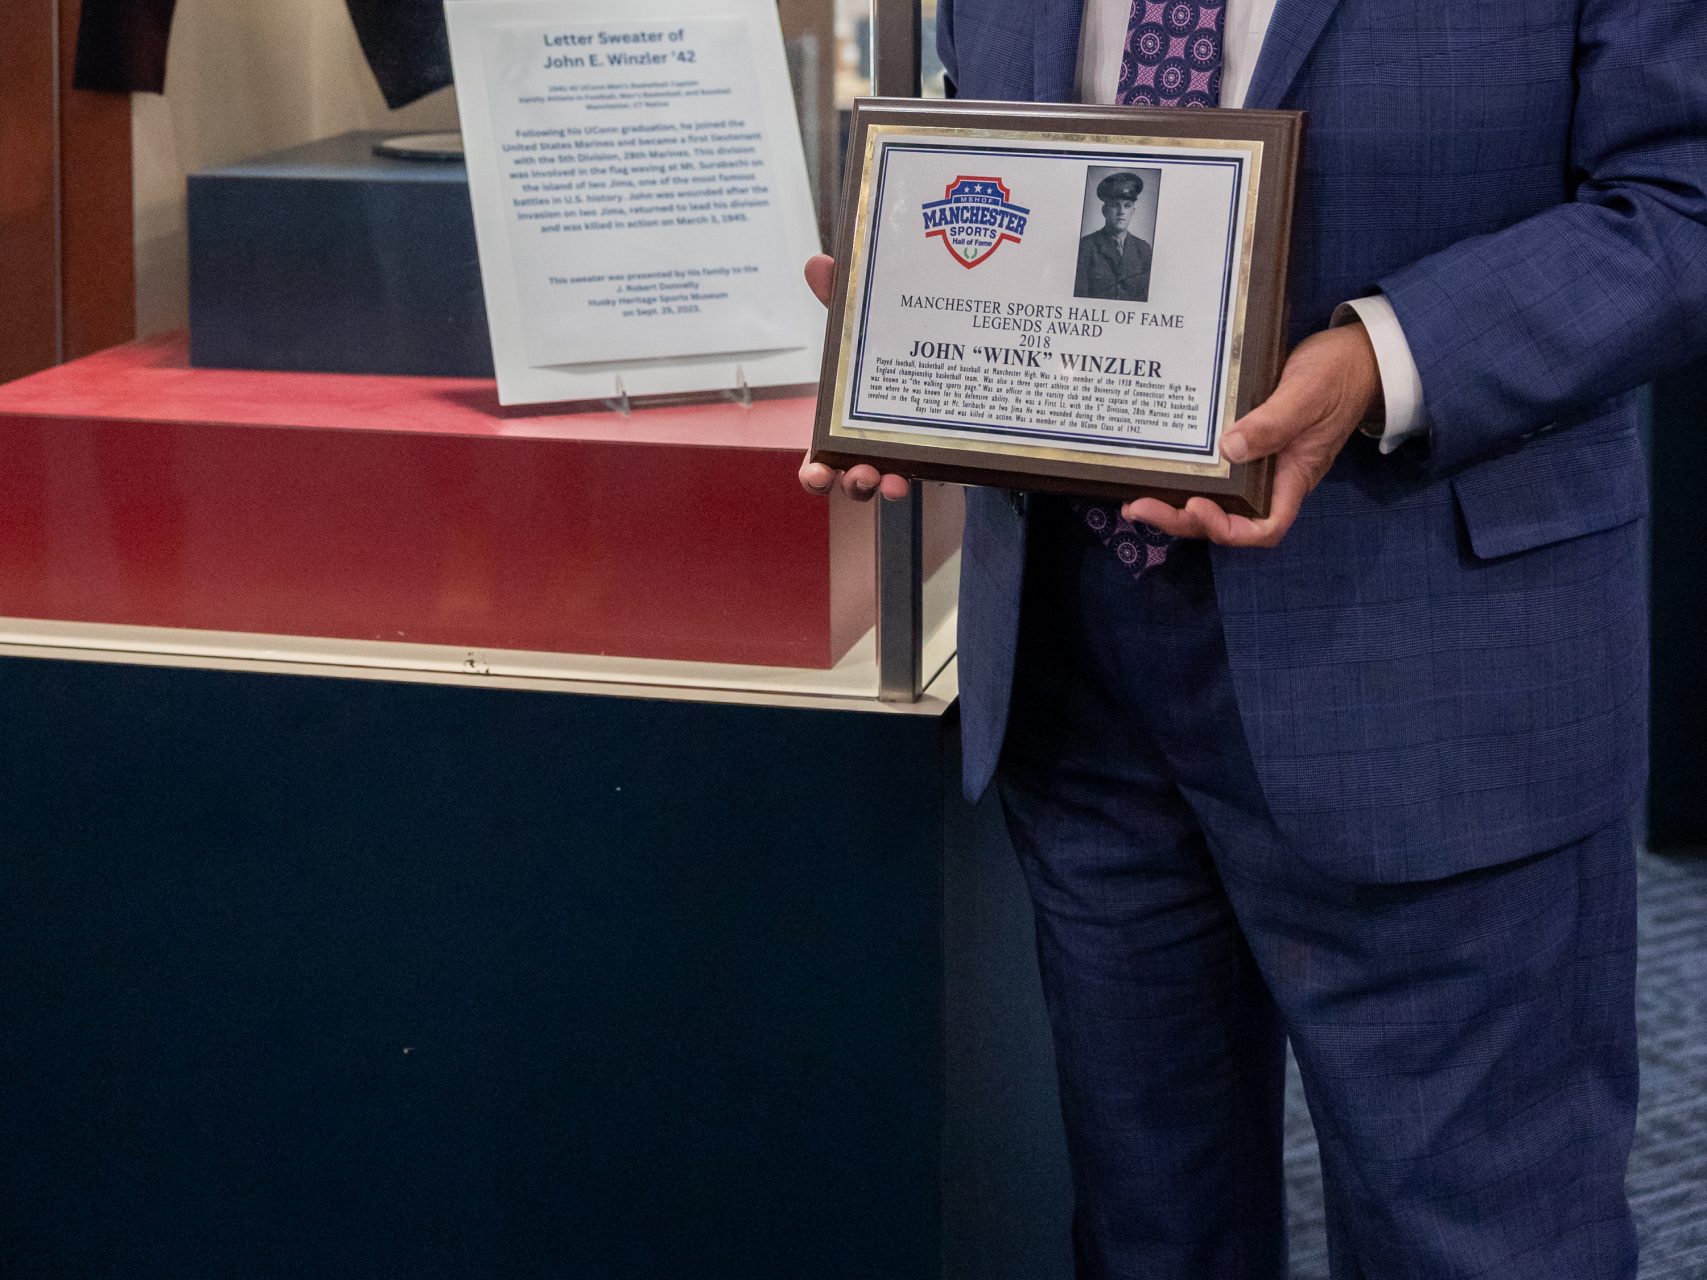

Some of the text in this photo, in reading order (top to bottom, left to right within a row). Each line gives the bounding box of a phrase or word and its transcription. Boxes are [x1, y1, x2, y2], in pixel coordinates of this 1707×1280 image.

[543, 28, 684, 46] Letter Sweater of
[543, 49, 695, 69] John E. Winzler '42
[960, 196, 993, 204] MSHOF
[922, 205, 1027, 236] MANCHESTER
[950, 226, 997, 239] SPORTS
[900, 294, 1184, 329] MANCHESTER SPORTS HALL OF FAME
[972, 315, 1103, 338] LEGENDS AWARD
[1019, 334, 1051, 349] 2018
[909, 340, 966, 361] JOHN
[1060, 353, 1162, 379] WINZLER
[875, 365, 896, 375] England
[898, 367, 932, 379] championship
[935, 371, 961, 380] basketball
[983, 375, 993, 383] Was
[996, 376, 1007, 384] also
[1016, 378, 1030, 386] three
[1033, 381, 1047, 389] sport
[1050, 382, 1069, 390] athlete
[1093, 385, 1120, 397] University
[1132, 388, 1164, 399] Connecticut
[1167, 392, 1184, 400] where
[876, 356, 892, 366] Played
[895, 358, 916, 368] football,
[918, 360, 944, 369] basketball
[959, 364, 981, 373] baseball
[992, 367, 1021, 376] Manchester
[1039, 371, 1050, 379] Was
[1072, 375, 1093, 383] member
[1096, 376, 1102, 384] of
[1105, 377, 1114, 385] the
[1134, 379, 1165, 389] Manchester
[1168, 383, 1181, 393] High
[1184, 384, 1196, 392] New
[882, 374, 898, 383] known
[923, 379, 943, 389] walking
[944, 382, 961, 391] sports
[982, 384, 992, 392] Was
[1005, 386, 1022, 395] officer
[1034, 389, 1043, 397] the
[1045, 392, 1064, 401] varsity
[1067, 392, 1078, 400] club
[1108, 397, 1128, 405] captain
[1140, 399, 1149, 407] the
[1153, 400, 1166, 408] 1942
[1170, 401, 1198, 411] basketball
[867, 391, 888, 400] involved
[899, 393, 907, 401] the
[910, 395, 920, 405] flag
[922, 398, 940, 407] raising
[998, 403, 1008, 411] Iwo
[1010, 404, 1022, 413] Jima
[1075, 411, 1093, 421] during
[1096, 413, 1105, 421] the
[1134, 418, 1159, 426] returned
[1171, 420, 1184, 429] duty
[915, 404, 926, 414] days
[929, 406, 942, 414] later
[969, 409, 984, 418] killed
[1015, 414, 1025, 422] Was
[1035, 417, 1056, 425] member
[1059, 418, 1065, 426] of
[1068, 419, 1077, 427] the
[1080, 420, 1097, 429] UConn
[1100, 422, 1114, 431] Class
